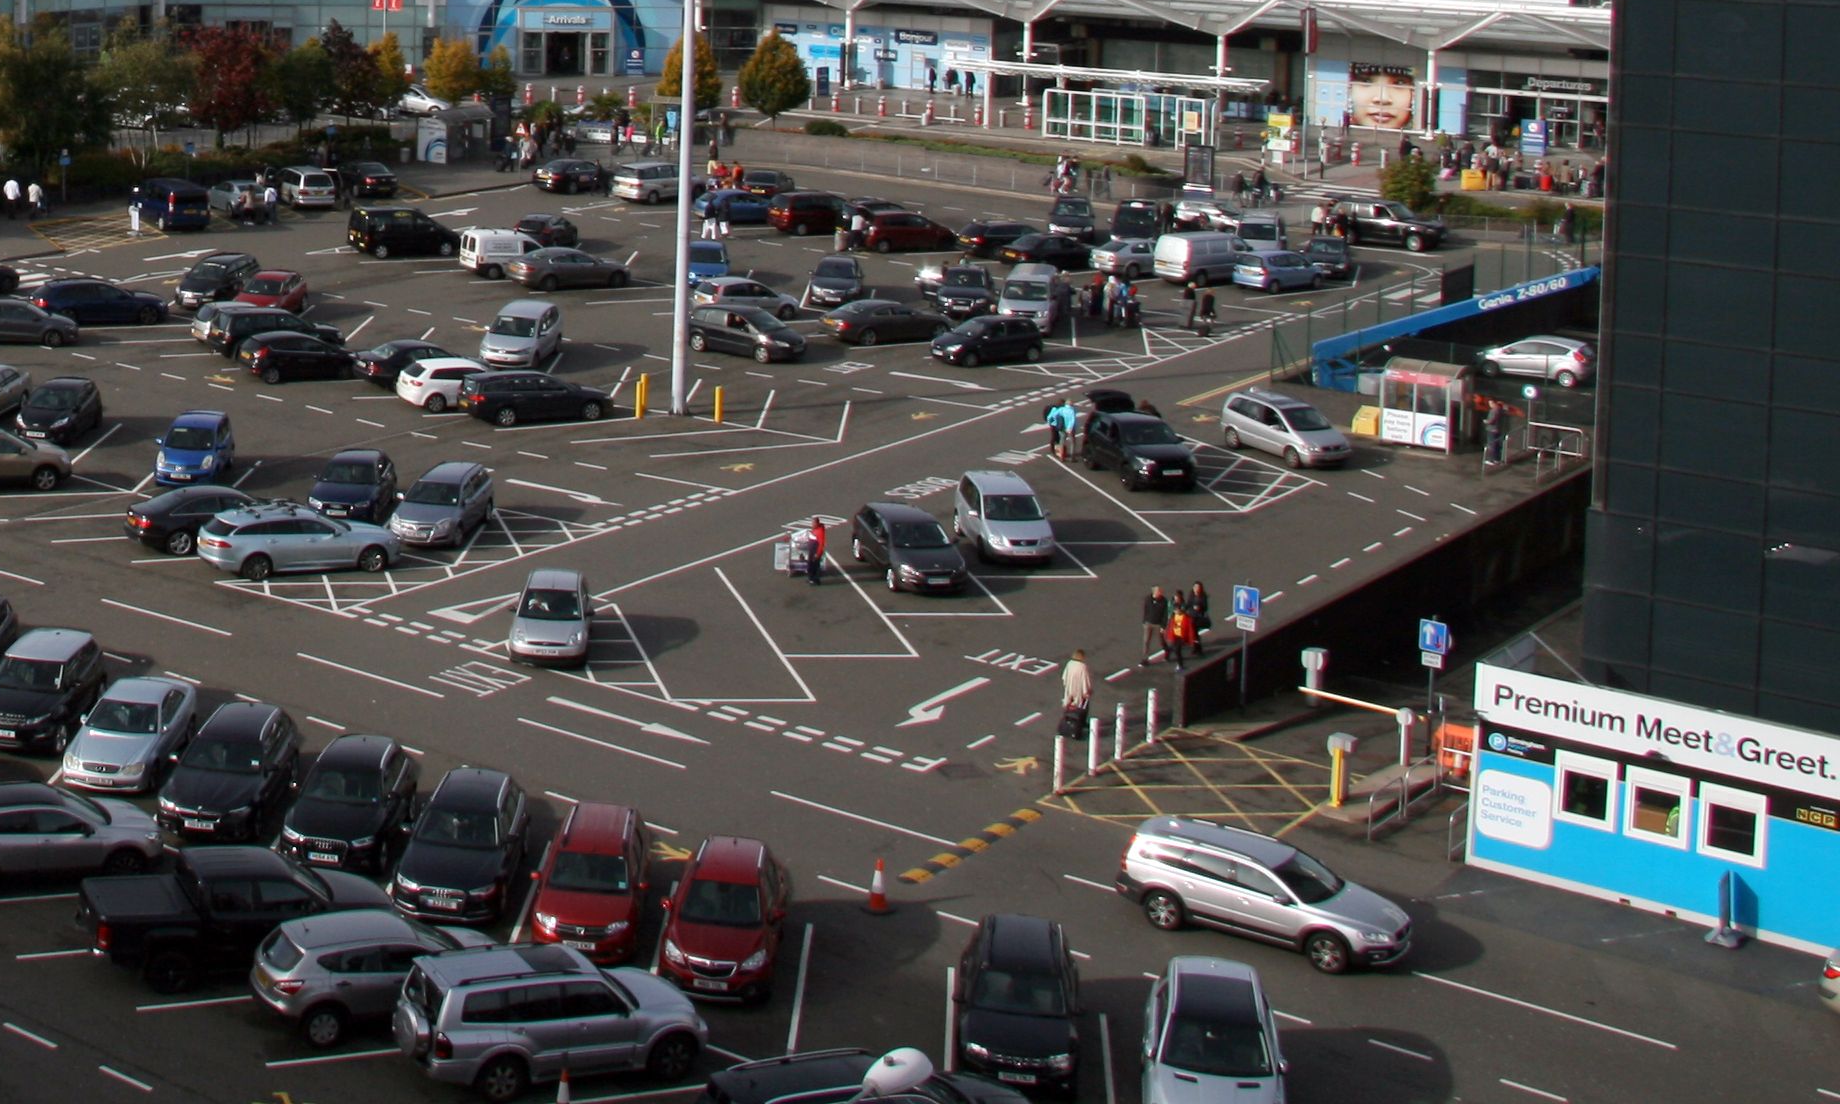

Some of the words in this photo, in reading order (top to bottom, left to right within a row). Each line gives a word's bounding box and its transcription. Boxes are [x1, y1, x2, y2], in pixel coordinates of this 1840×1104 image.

[548, 14, 587, 26] Arrivals
[898, 31, 935, 45] Bonjour
[1526, 76, 1593, 92] Departures
[1477, 293, 1514, 311] Genie
[1516, 276, 1568, 301] Z-80/60
[963, 649, 1059, 676] EXIT
[428, 660, 532, 698] EXIT
[1493, 682, 1626, 734] Premium
[1481, 784, 1526, 805] Parking
[1481, 797, 1538, 818] Customer
[1796, 807, 1836, 827] NCP
[1480, 809, 1523, 828] Service
